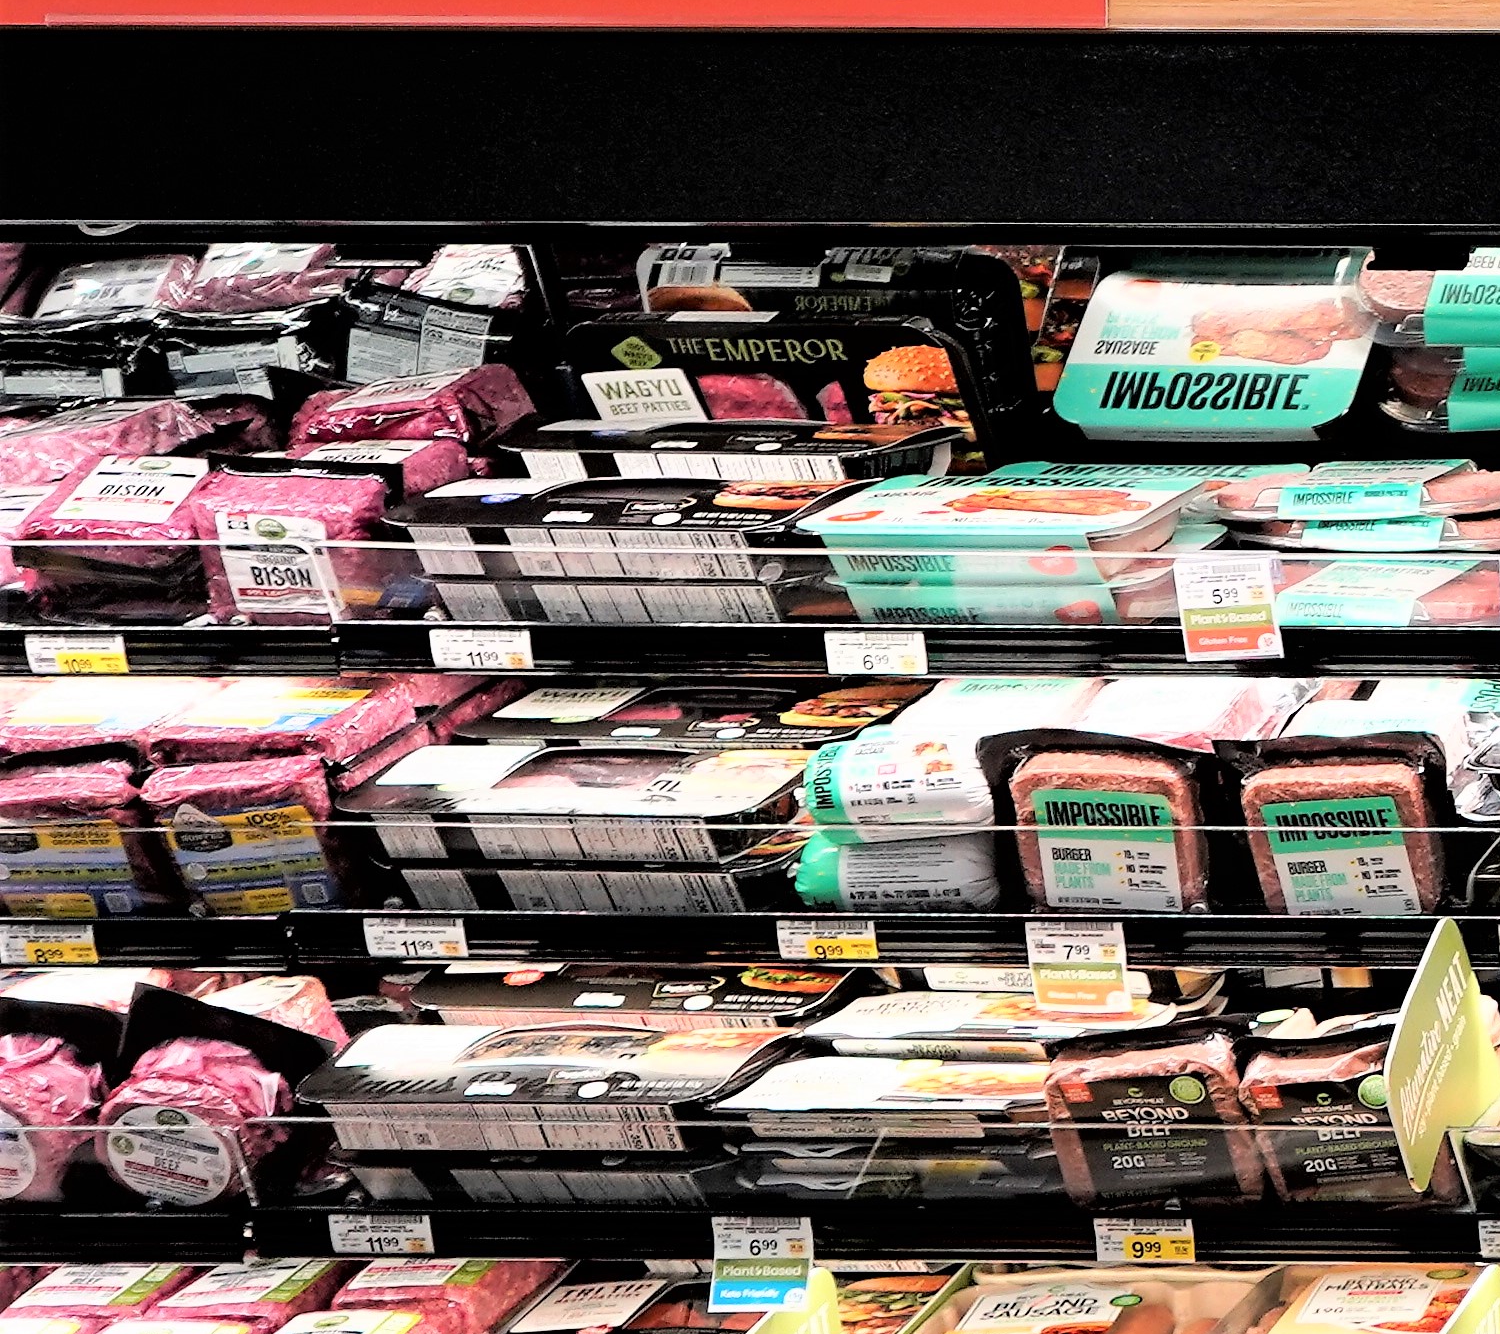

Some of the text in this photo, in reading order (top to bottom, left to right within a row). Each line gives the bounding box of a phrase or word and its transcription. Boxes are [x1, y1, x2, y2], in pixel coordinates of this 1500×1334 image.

[666, 337, 848, 364] THE EMPEROR
[597, 378, 682, 400] WAGYU
[642, 400, 691, 415] PATTIES
[99, 484, 165, 498] BISON
[1293, 491, 1356, 507] IMPOSSIBLE
[251, 566, 313, 588] BISON
[1045, 800, 1160, 827] IMPOSSIBLE
[1275, 810, 1390, 843] IMPOSSIBLE
[1052, 848, 1092, 861] BURGER
[1289, 859, 1328, 875] BURGER
[1436, 950, 1468, 1032] MEAT
[1101, 1107, 1190, 1122] BEYOND
[1291, 1113, 1379, 1127] BEYOND
